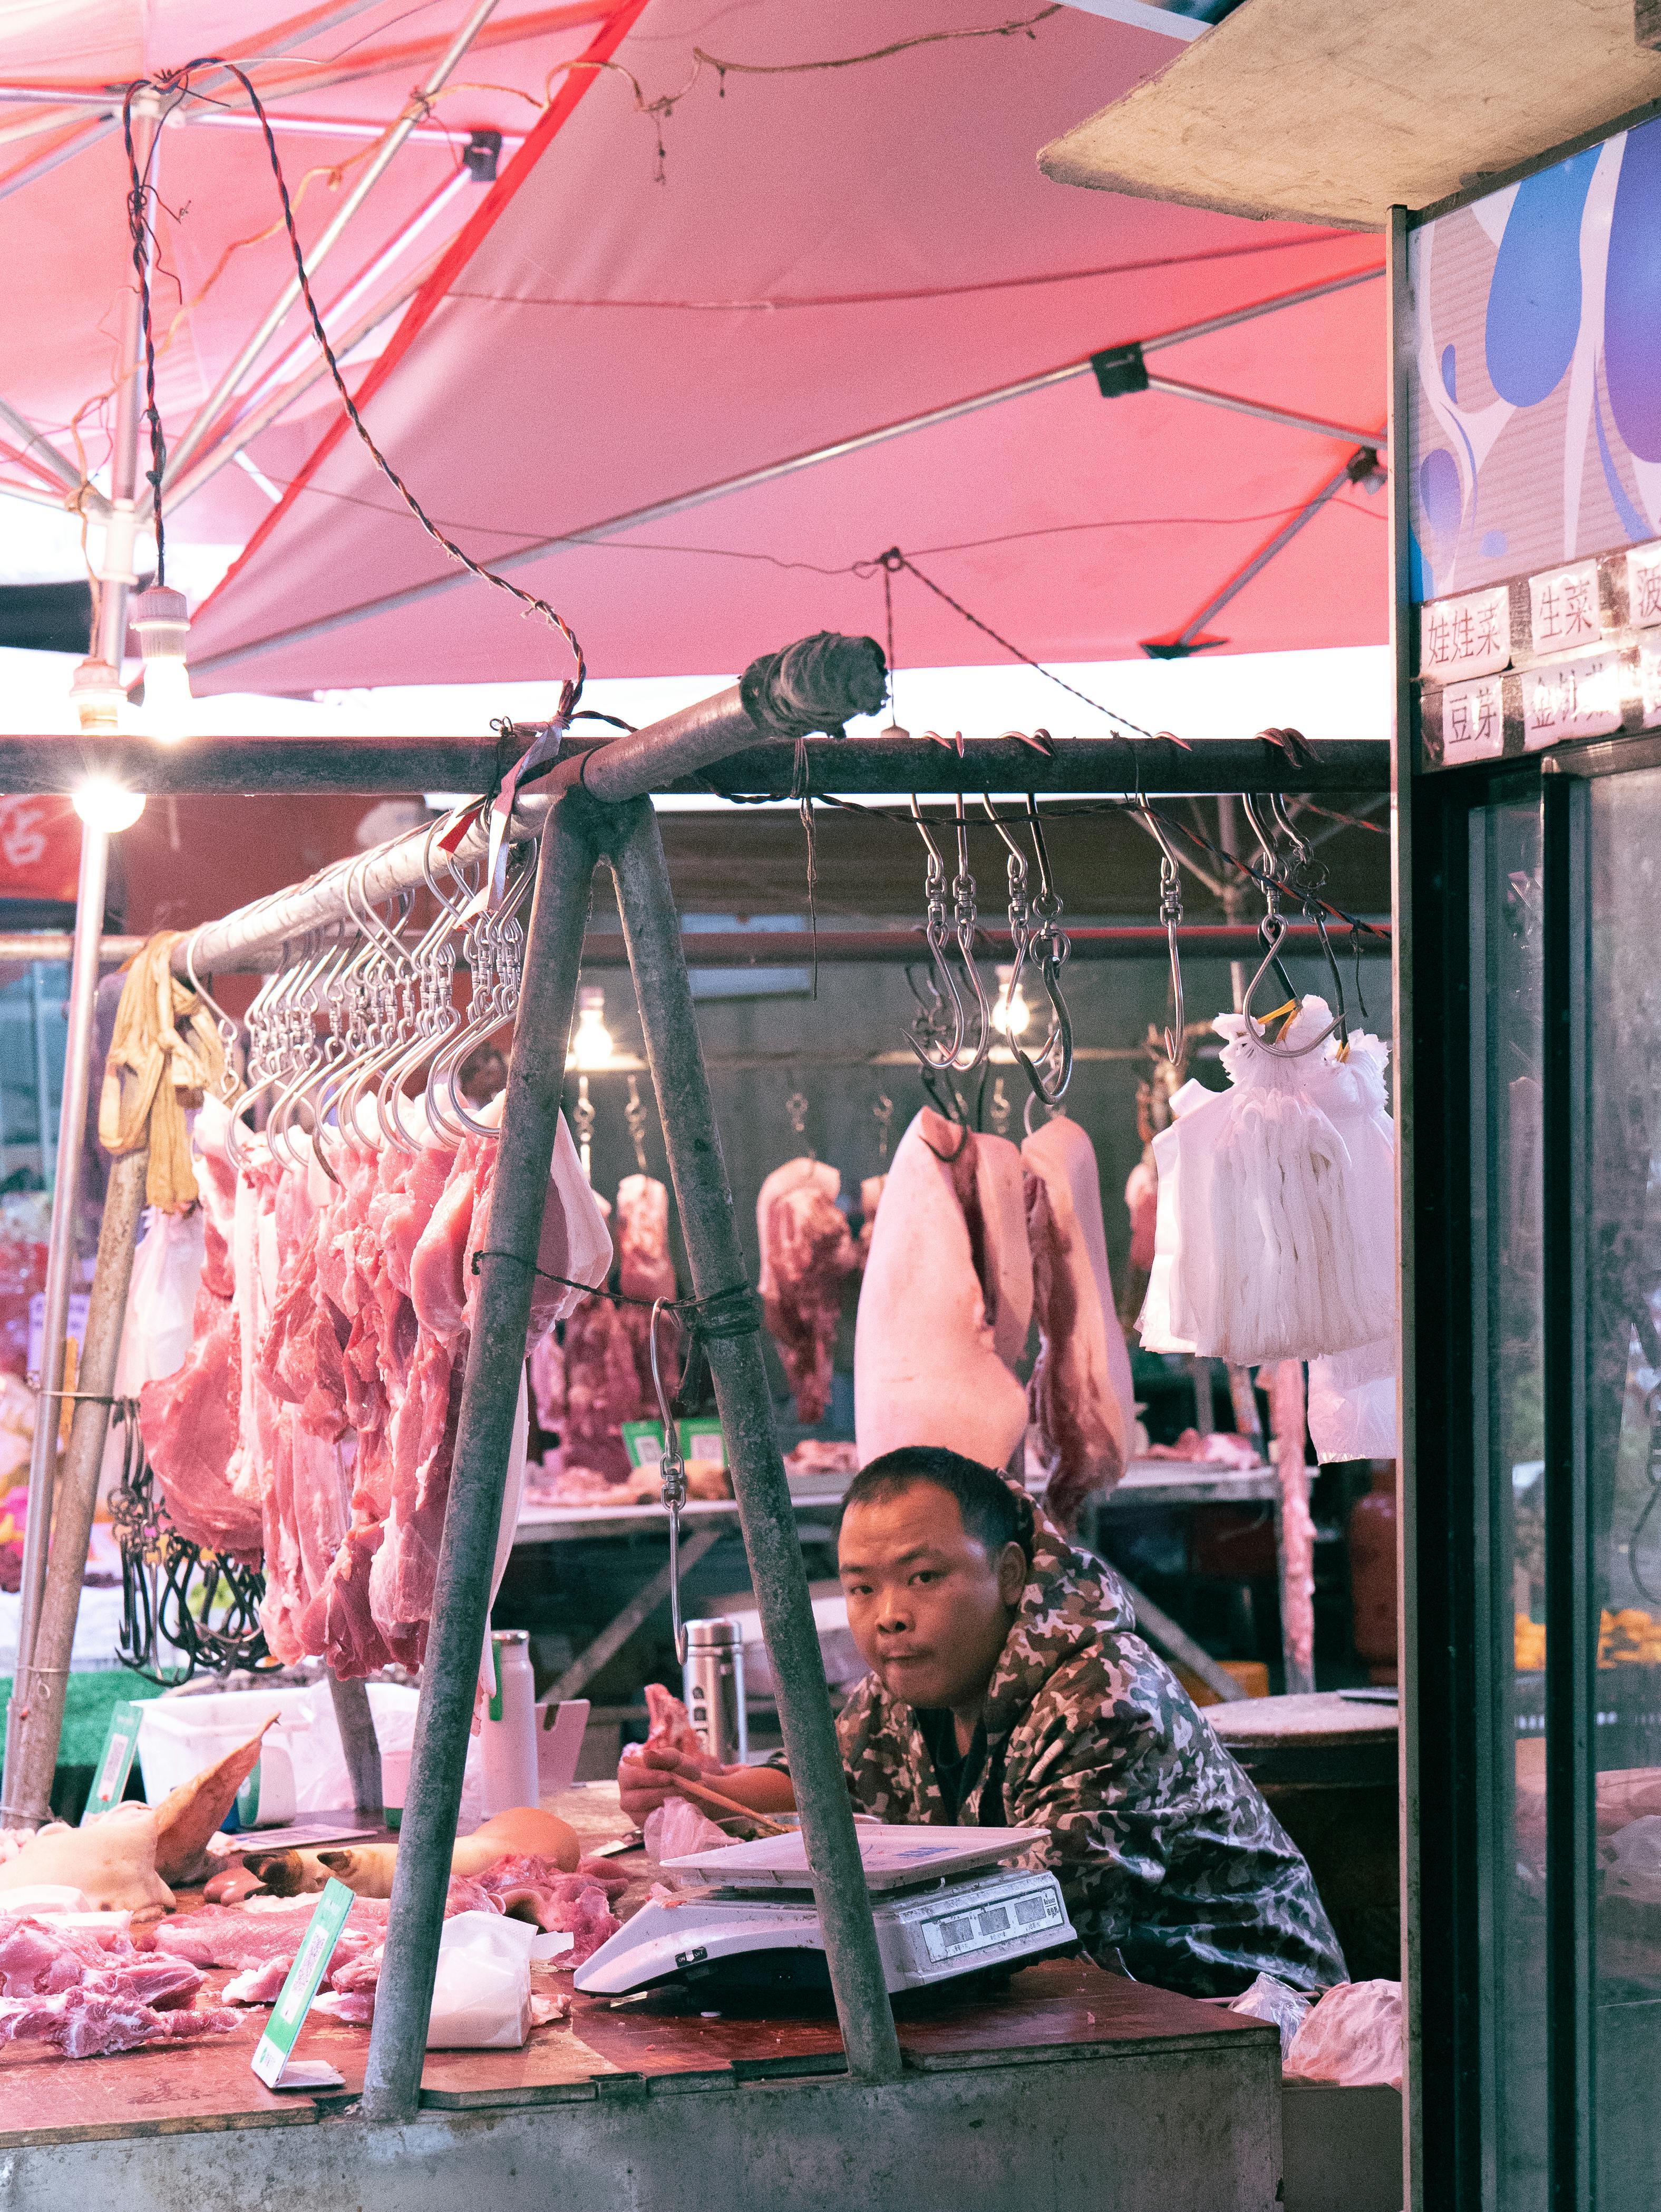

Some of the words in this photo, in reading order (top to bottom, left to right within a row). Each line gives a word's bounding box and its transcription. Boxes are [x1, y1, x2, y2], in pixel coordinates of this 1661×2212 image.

[1428, 603, 1500, 668] 娃娃菜
[1540, 579, 1592, 640] 生菜
[1448, 688, 1498, 744] 豆芽
